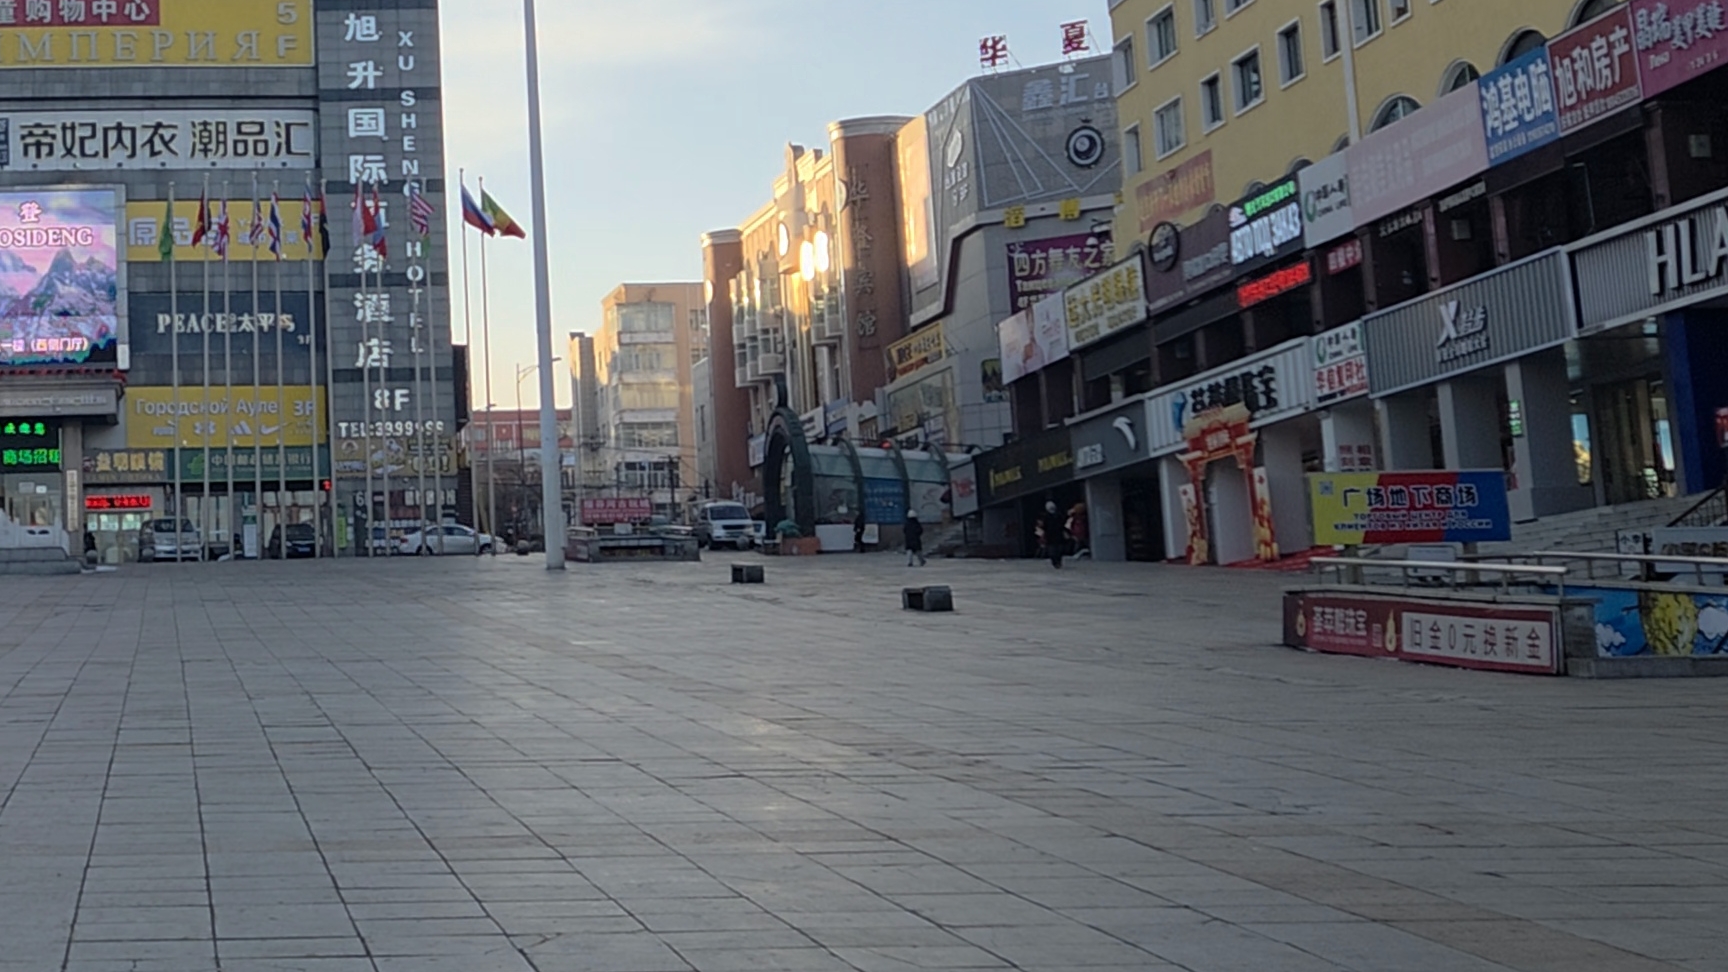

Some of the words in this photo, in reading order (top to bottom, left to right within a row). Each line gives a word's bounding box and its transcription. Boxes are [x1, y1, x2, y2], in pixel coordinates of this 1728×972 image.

[397, 31, 414, 71] XU
[978, 20, 1090, 67] 华夏
[1555, 24, 1631, 108] 旭和房产
[1480, 57, 1553, 138] 鸿基电脑
[374, 389, 410, 412] 8F
[1343, 485, 1479, 508] 广场地下商场
[1410, 616, 1541, 659] 旧金0元换新金
